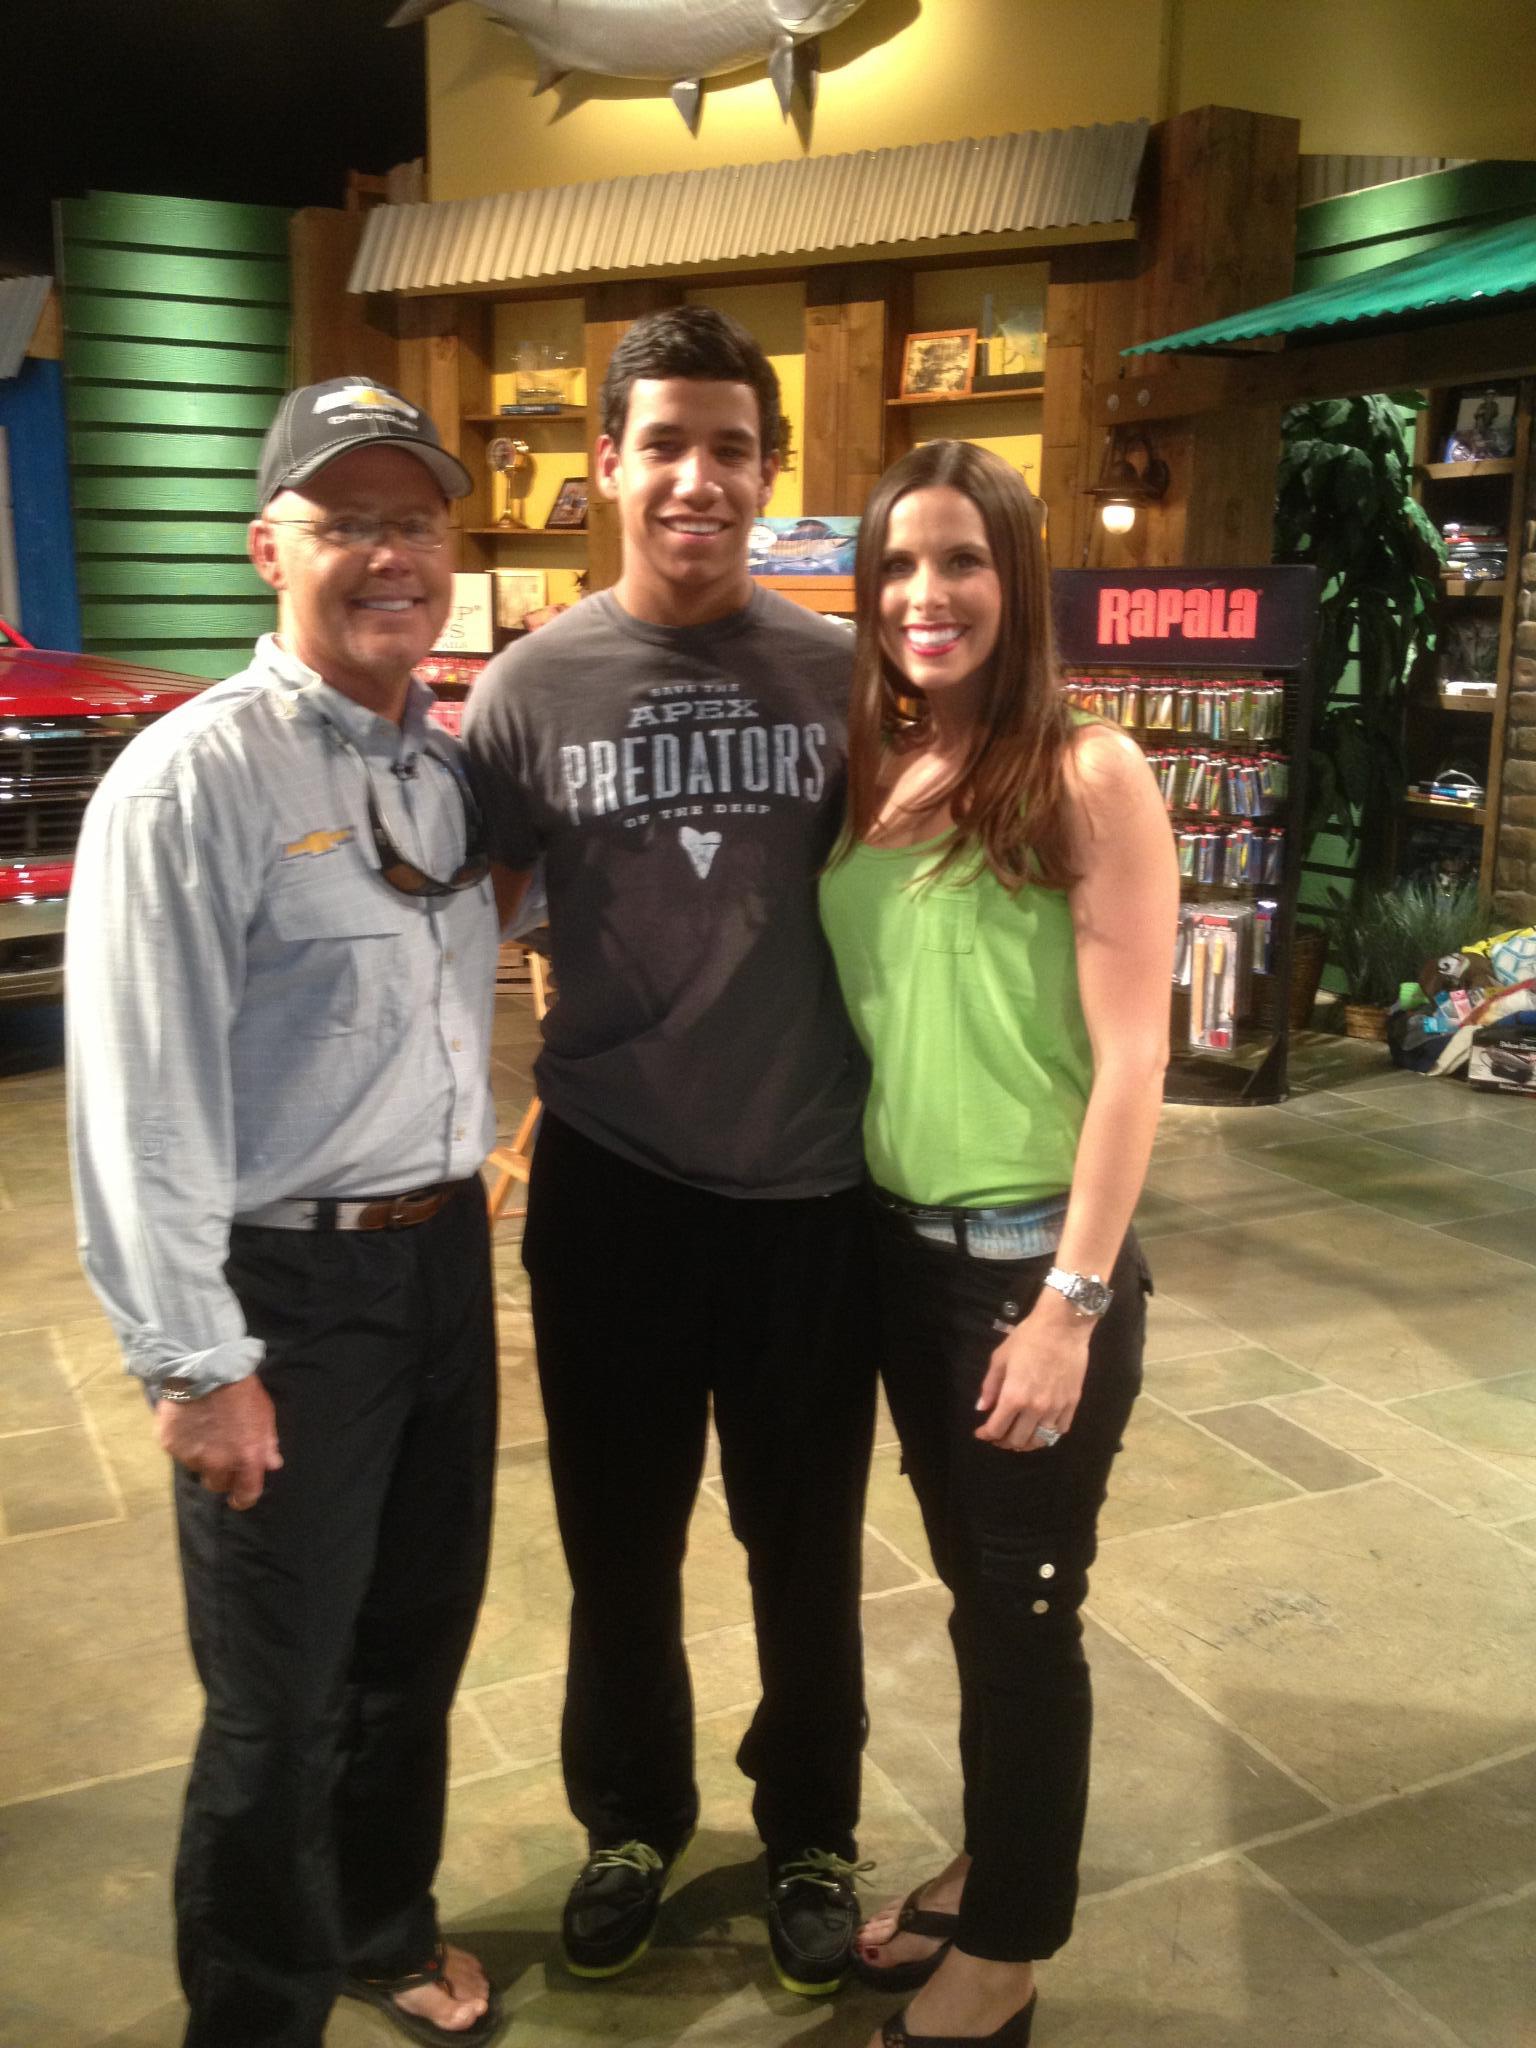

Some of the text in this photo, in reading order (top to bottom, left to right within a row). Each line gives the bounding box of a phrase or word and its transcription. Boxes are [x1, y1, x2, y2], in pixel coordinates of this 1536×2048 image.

[626, 699, 760, 729] APEX
[558, 722, 828, 827] PREDATORS
[623, 803, 771, 829] OF THE DEEP
